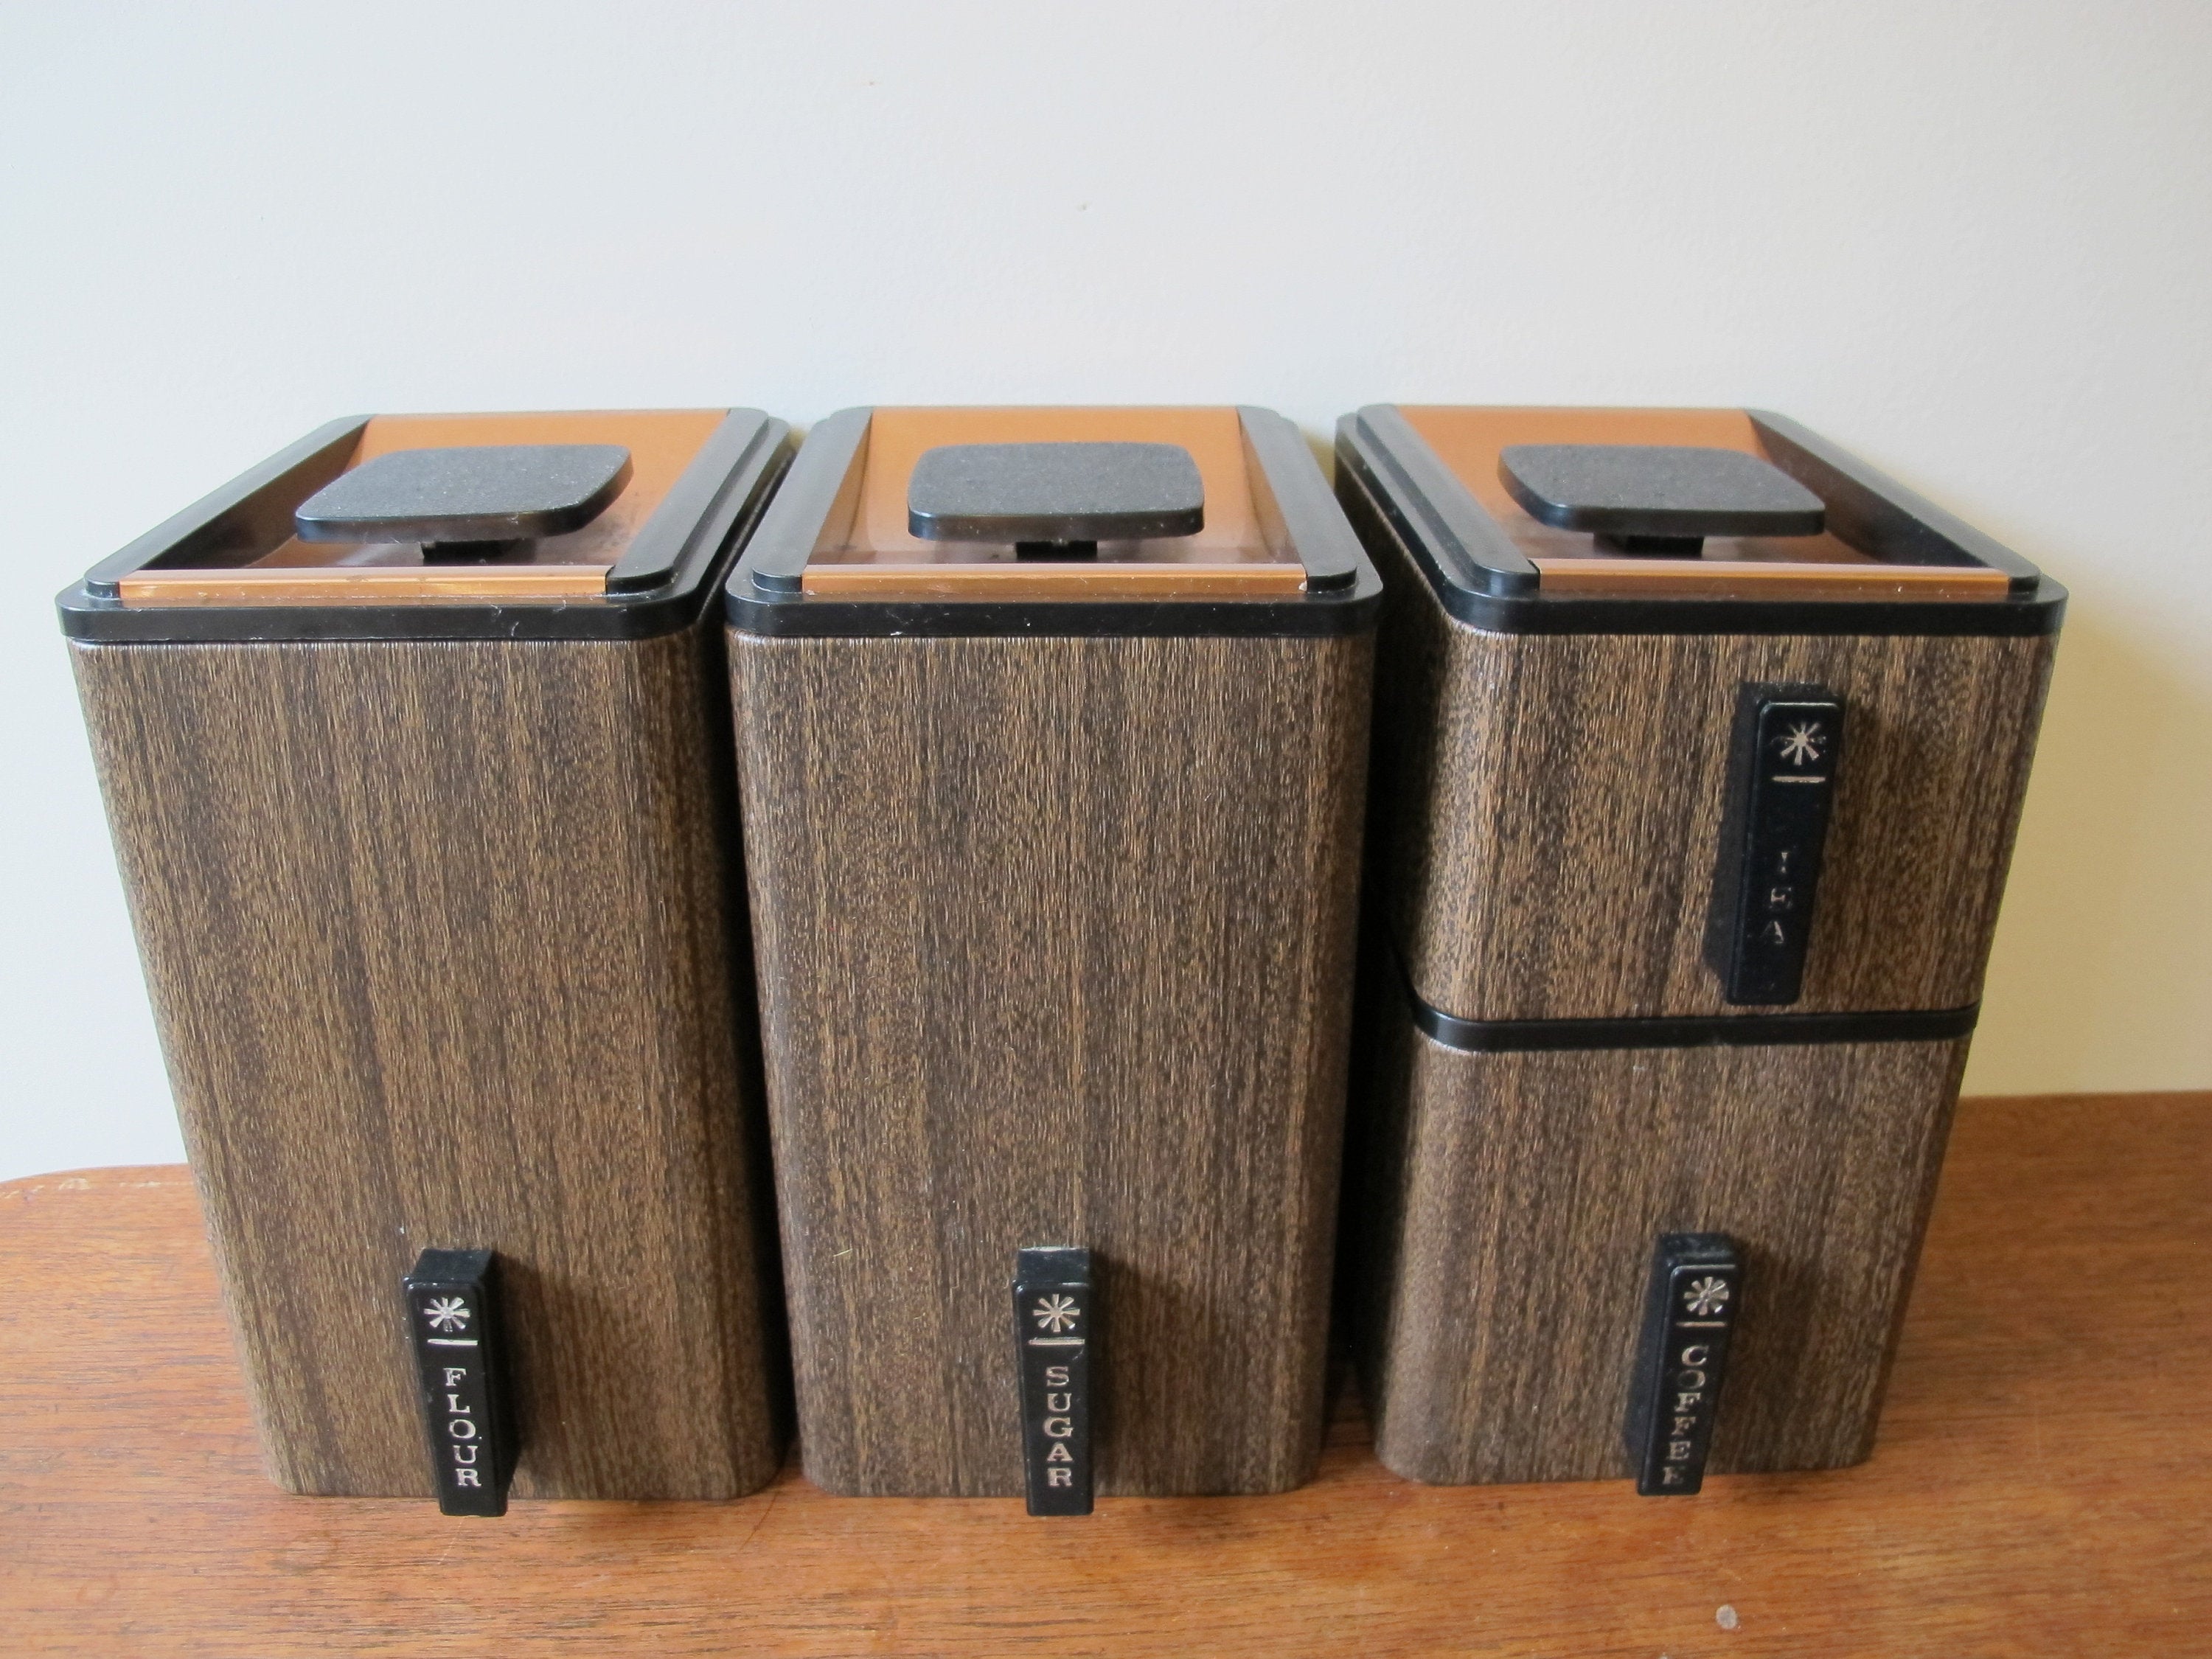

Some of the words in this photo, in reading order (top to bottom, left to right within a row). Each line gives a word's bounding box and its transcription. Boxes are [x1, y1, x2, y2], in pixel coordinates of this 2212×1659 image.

[443, 1367, 481, 1487] FLOUR
[1042, 1366, 1074, 1487] SUGAR
[1662, 1345, 1710, 1485] COFFEE
